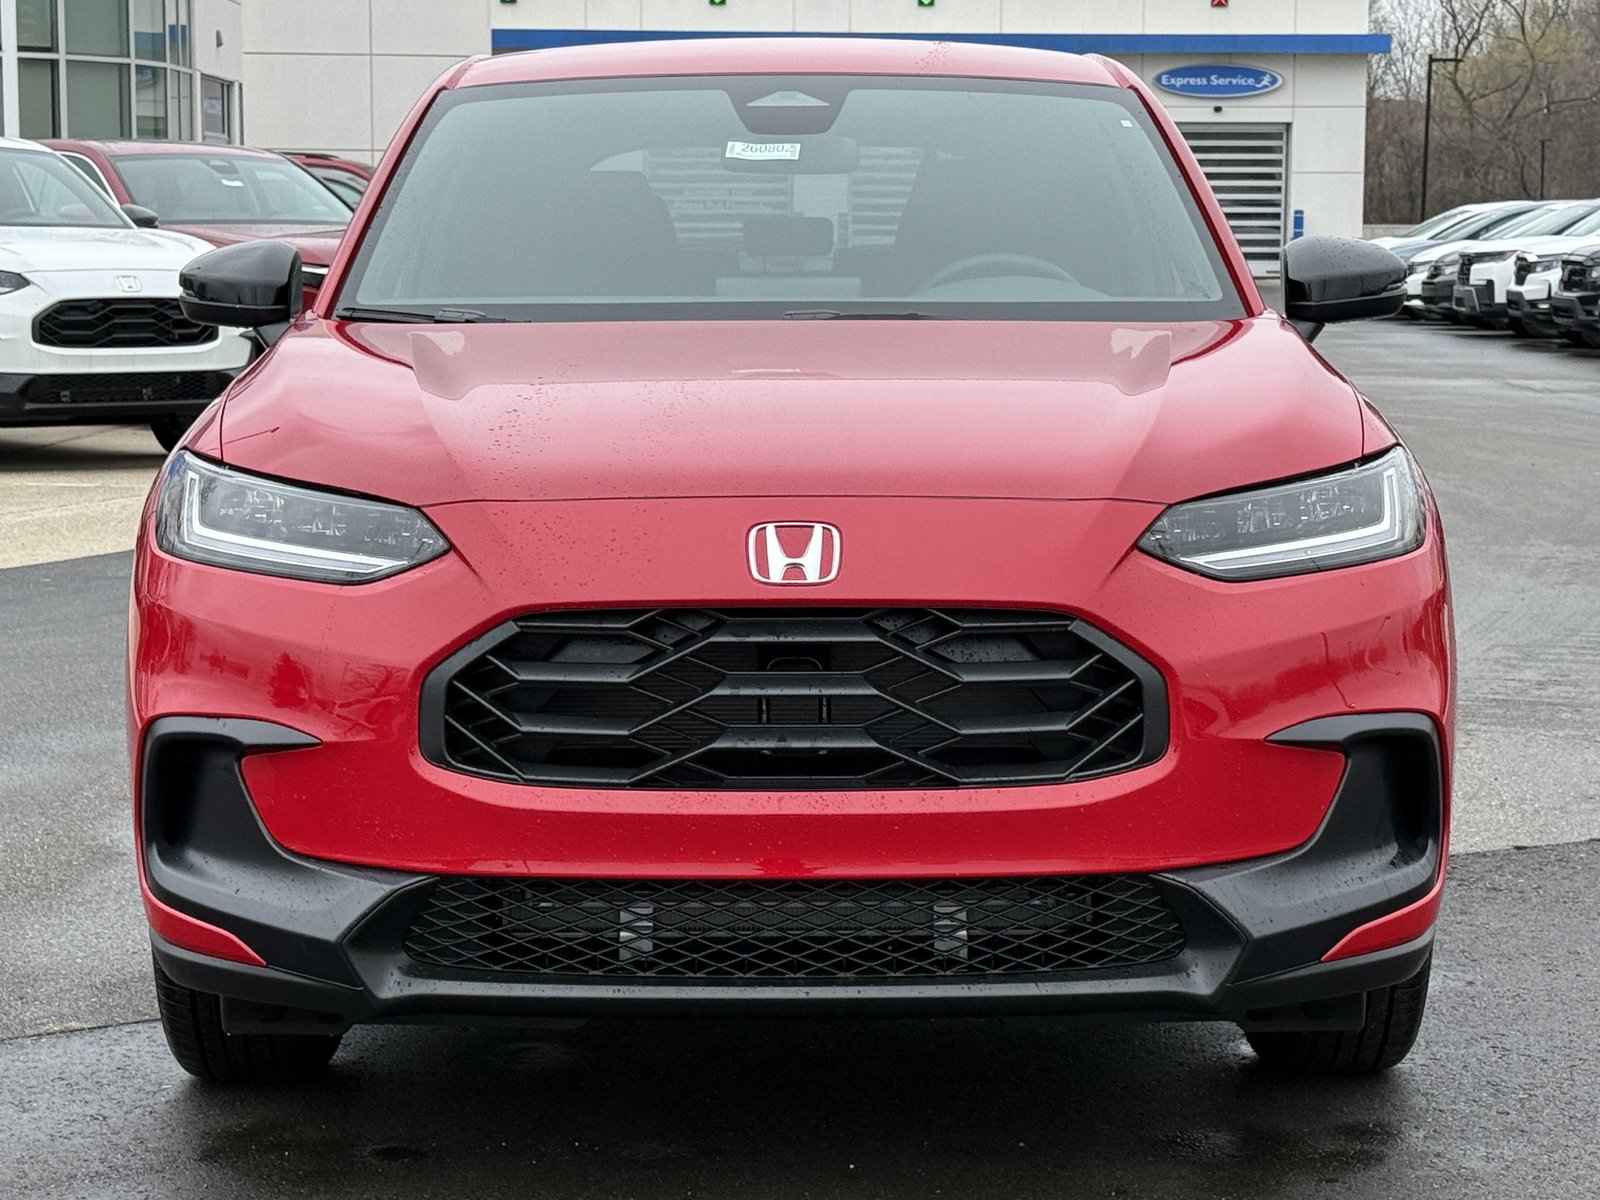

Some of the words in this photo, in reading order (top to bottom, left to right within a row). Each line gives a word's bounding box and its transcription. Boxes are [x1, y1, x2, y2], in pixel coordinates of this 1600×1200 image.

[1161, 74, 1207, 87] Express
[1210, 74, 1255, 86] Service
[740, 143, 794, 153] 260802
